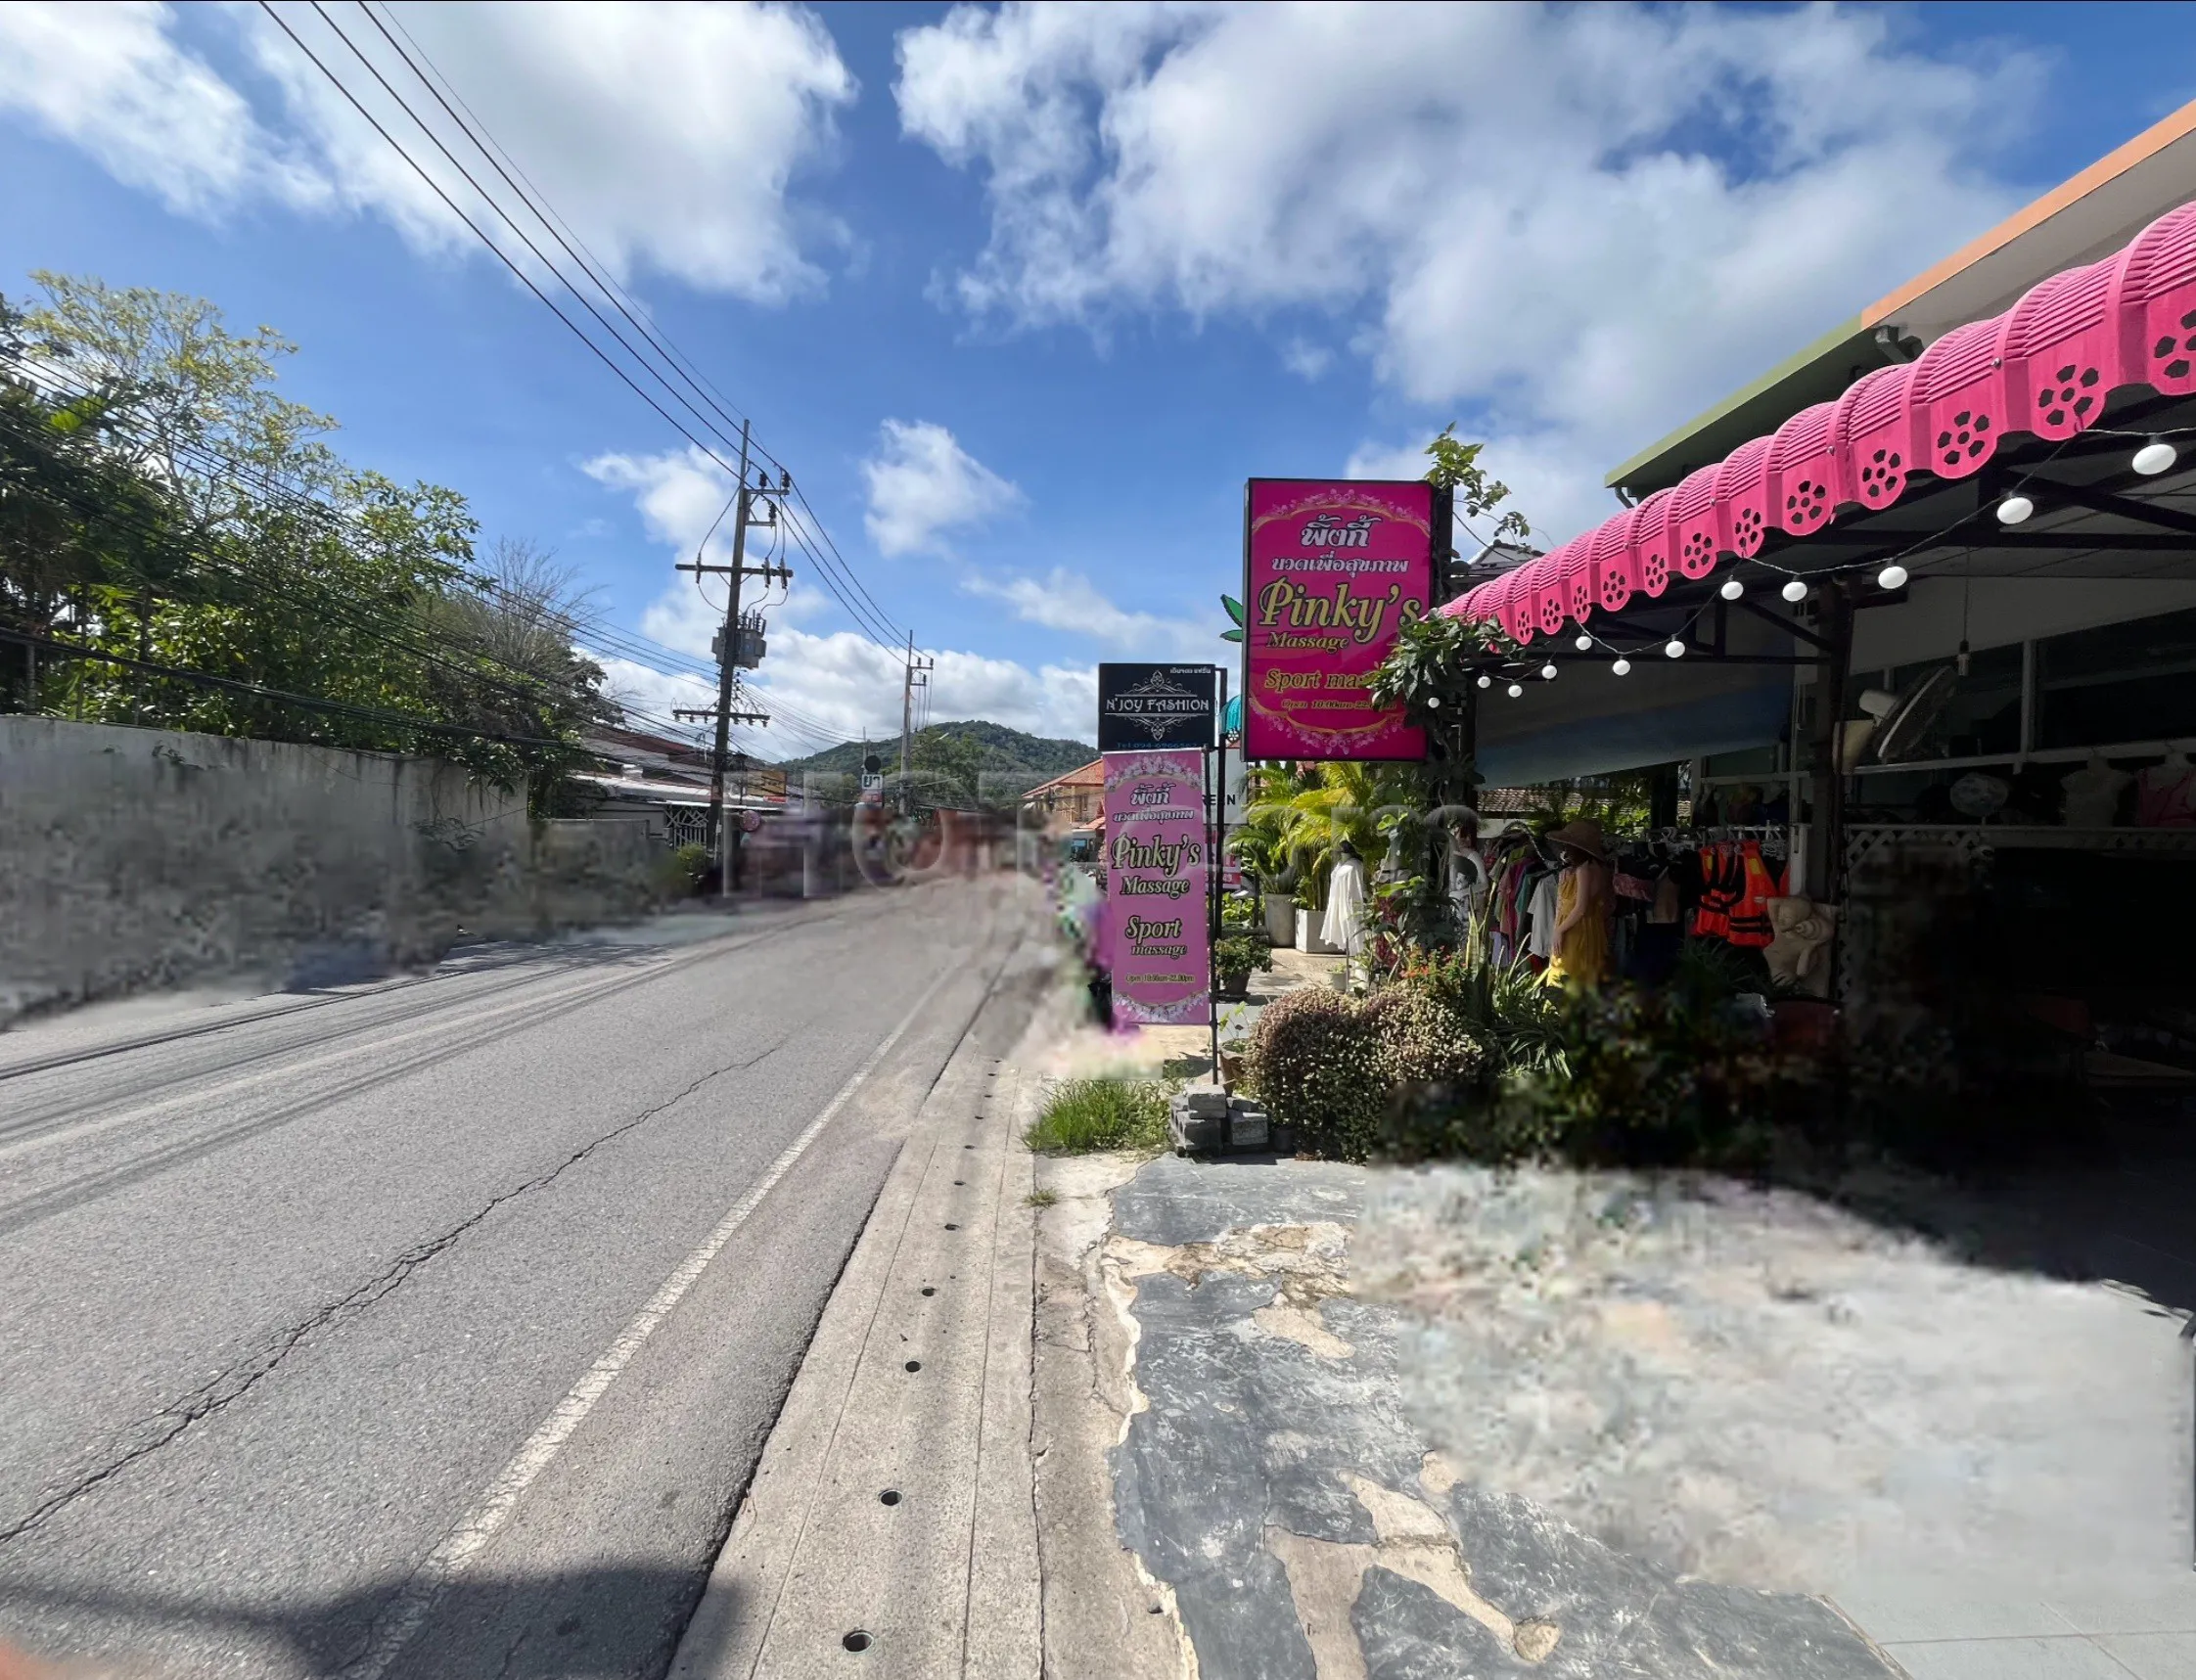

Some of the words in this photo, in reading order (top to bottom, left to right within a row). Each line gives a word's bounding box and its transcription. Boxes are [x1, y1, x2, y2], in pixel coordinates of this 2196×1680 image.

[1271, 550, 1409, 578] นวดเพื่อสุขภาพ
[1258, 576, 1422, 644] Pinky's
[1265, 631, 1350, 655] Massage
[1264, 669, 1320, 692] Sport
[1105, 698, 1144, 711] N'JOY
[1146, 698, 1210, 711] FASHION
[1281, 699, 1307, 710] Open
[1112, 833, 1201, 878] Pinky's
[1120, 876, 1190, 899] Massage
[1124, 915, 1183, 945] Sport
[1130, 943, 1187, 960] massage
